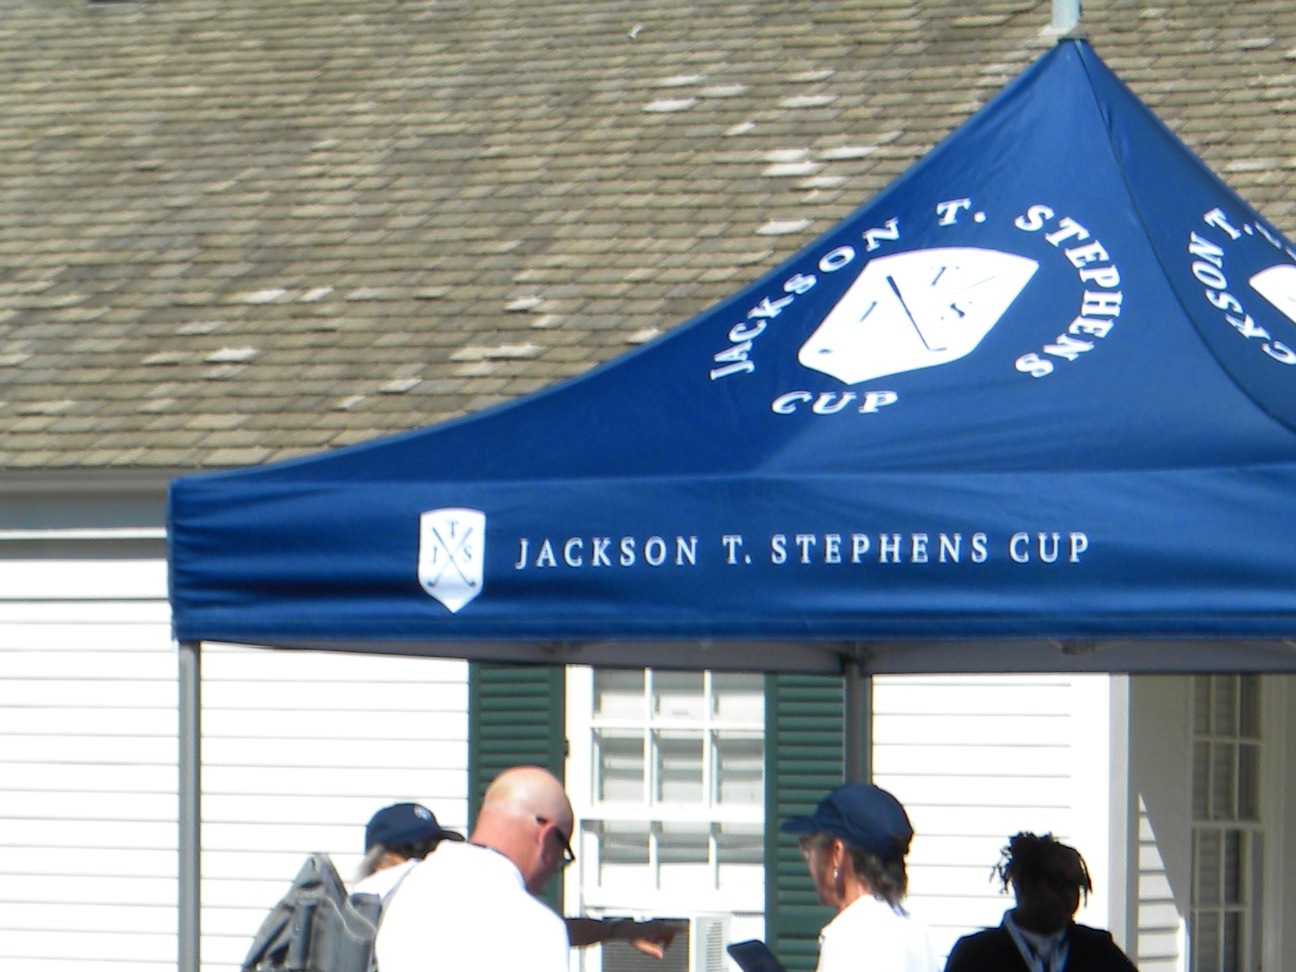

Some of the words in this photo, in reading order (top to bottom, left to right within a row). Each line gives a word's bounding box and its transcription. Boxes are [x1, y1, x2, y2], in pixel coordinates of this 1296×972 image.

[1203, 207, 1254, 241] T.
[710, 217, 900, 380] JACKSON
[936, 198, 987, 226] T.
[1015, 204, 1123, 378] STEPHENS
[771, 390, 899, 415] CUP
[515, 535, 699, 571] JACKSON
[722, 534, 752, 565] T.
[771, 532, 991, 564] STEPHENS
[1008, 531, 1090, 563] CUP
